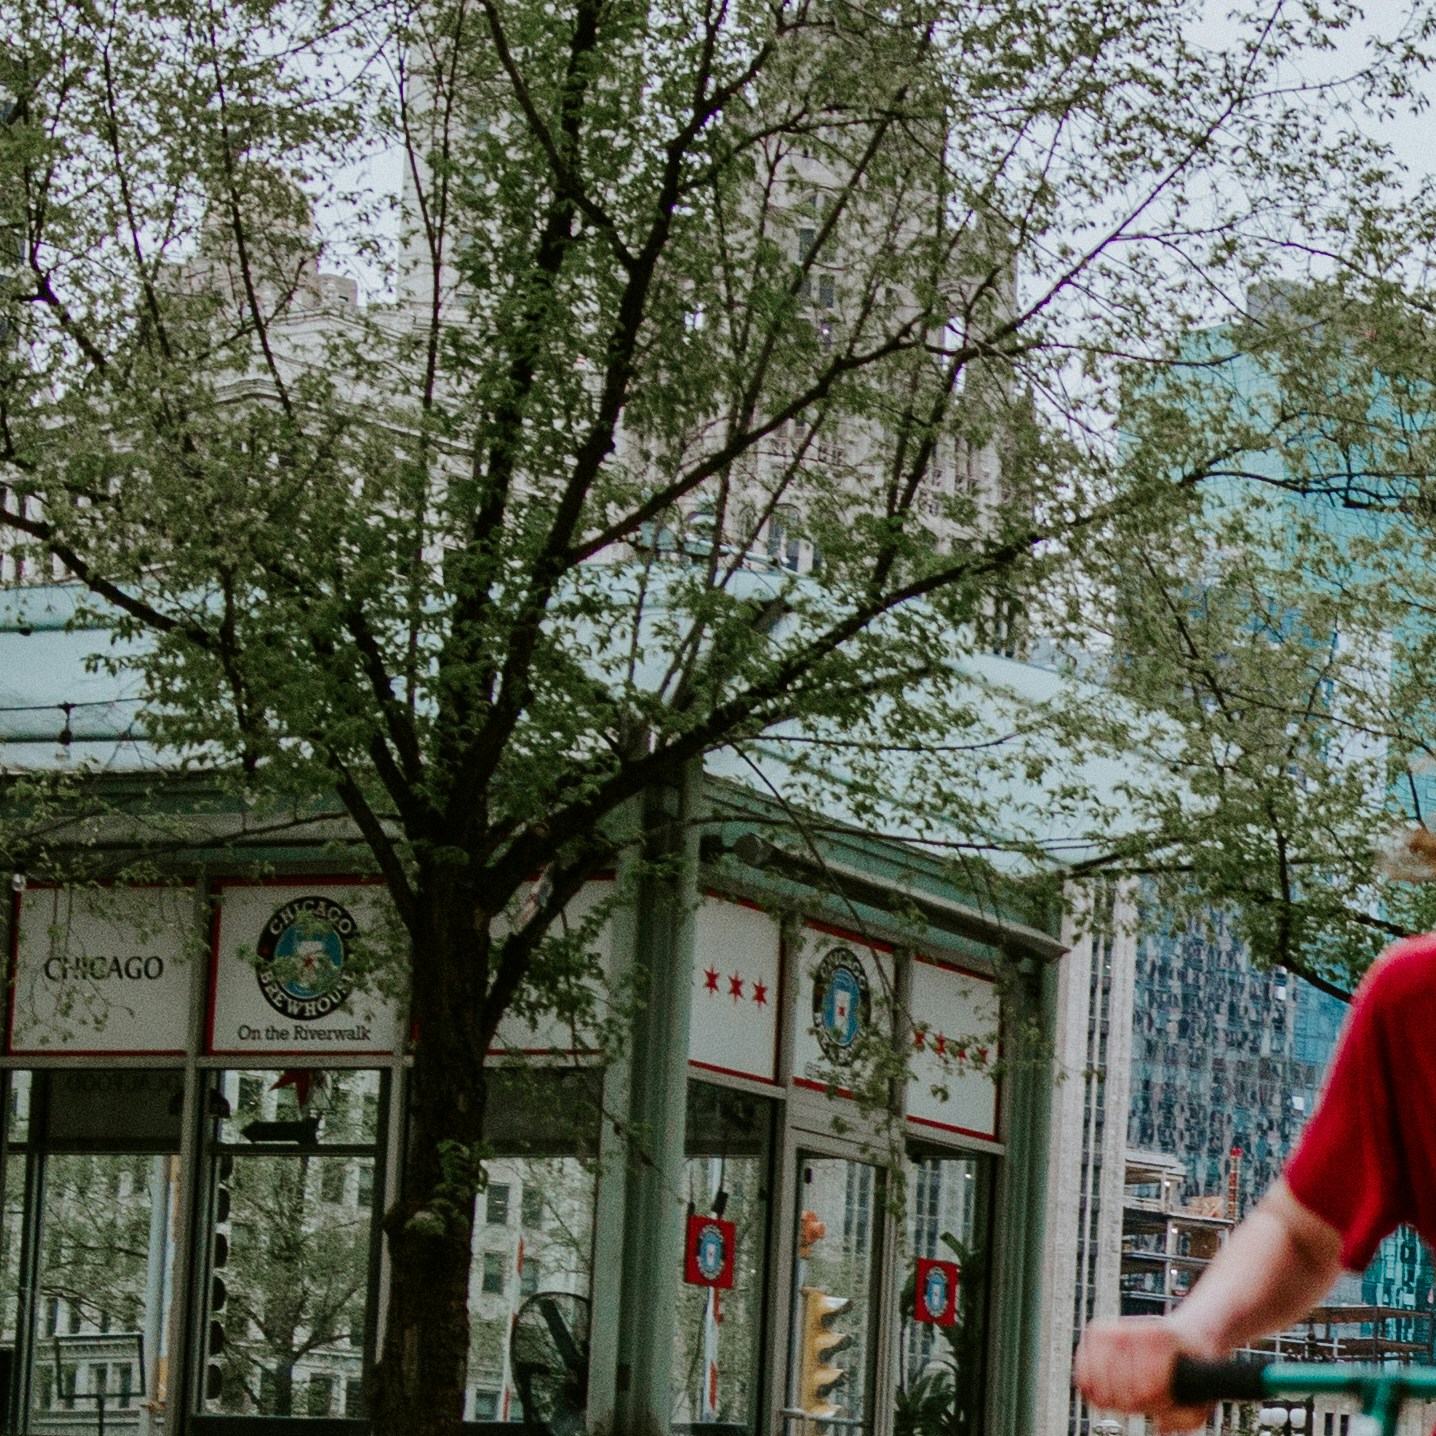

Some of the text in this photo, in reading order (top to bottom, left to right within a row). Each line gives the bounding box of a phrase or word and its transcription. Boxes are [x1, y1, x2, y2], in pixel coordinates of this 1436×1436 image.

[269, 900, 352, 935] CHICAGO
[44, 955, 164, 981] CHICAGO
[237, 1024, 371, 1041] On the Riverwalk
